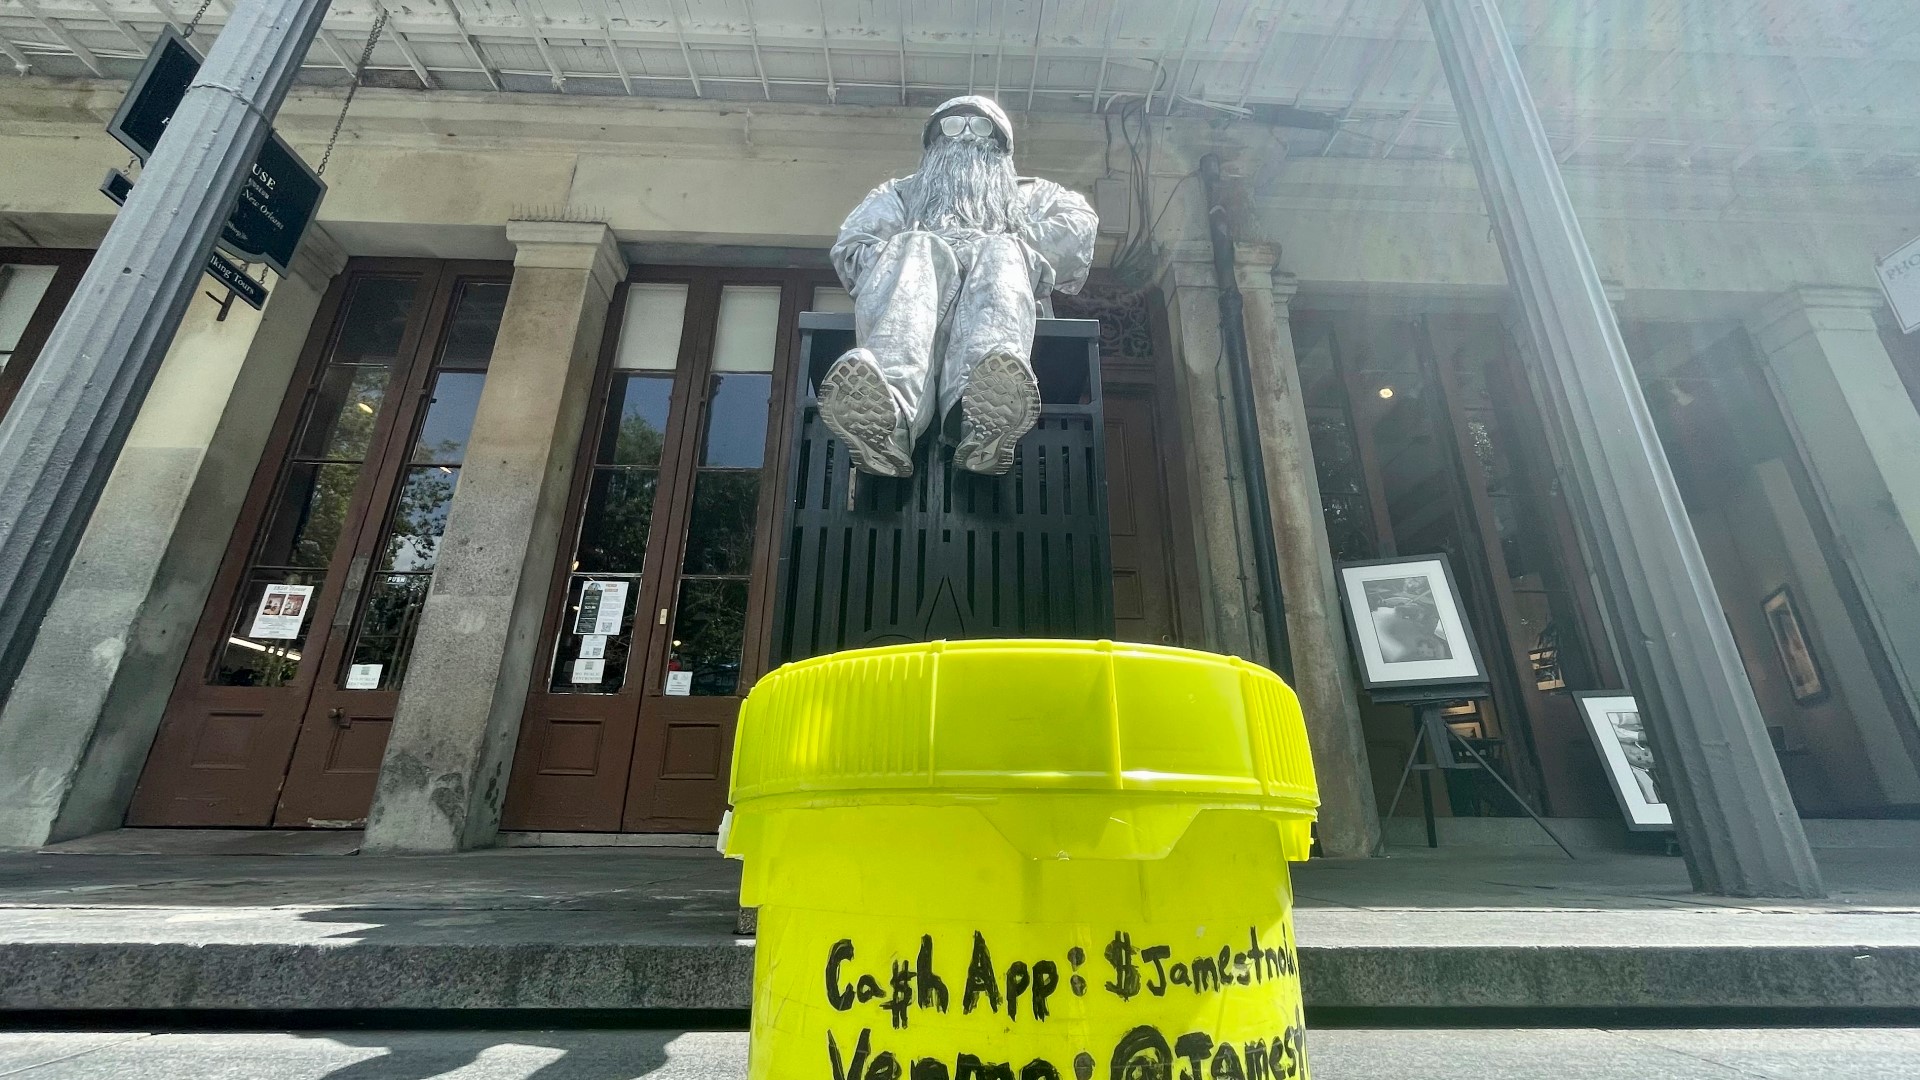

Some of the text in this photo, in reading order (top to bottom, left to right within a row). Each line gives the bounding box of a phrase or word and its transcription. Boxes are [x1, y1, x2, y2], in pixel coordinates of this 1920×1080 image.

[252, 163, 276, 190] USE
[241, 189, 284, 230] New Orleans
[234, 272, 254, 295] Tours
[825, 933, 949, 1030] Ca$h
